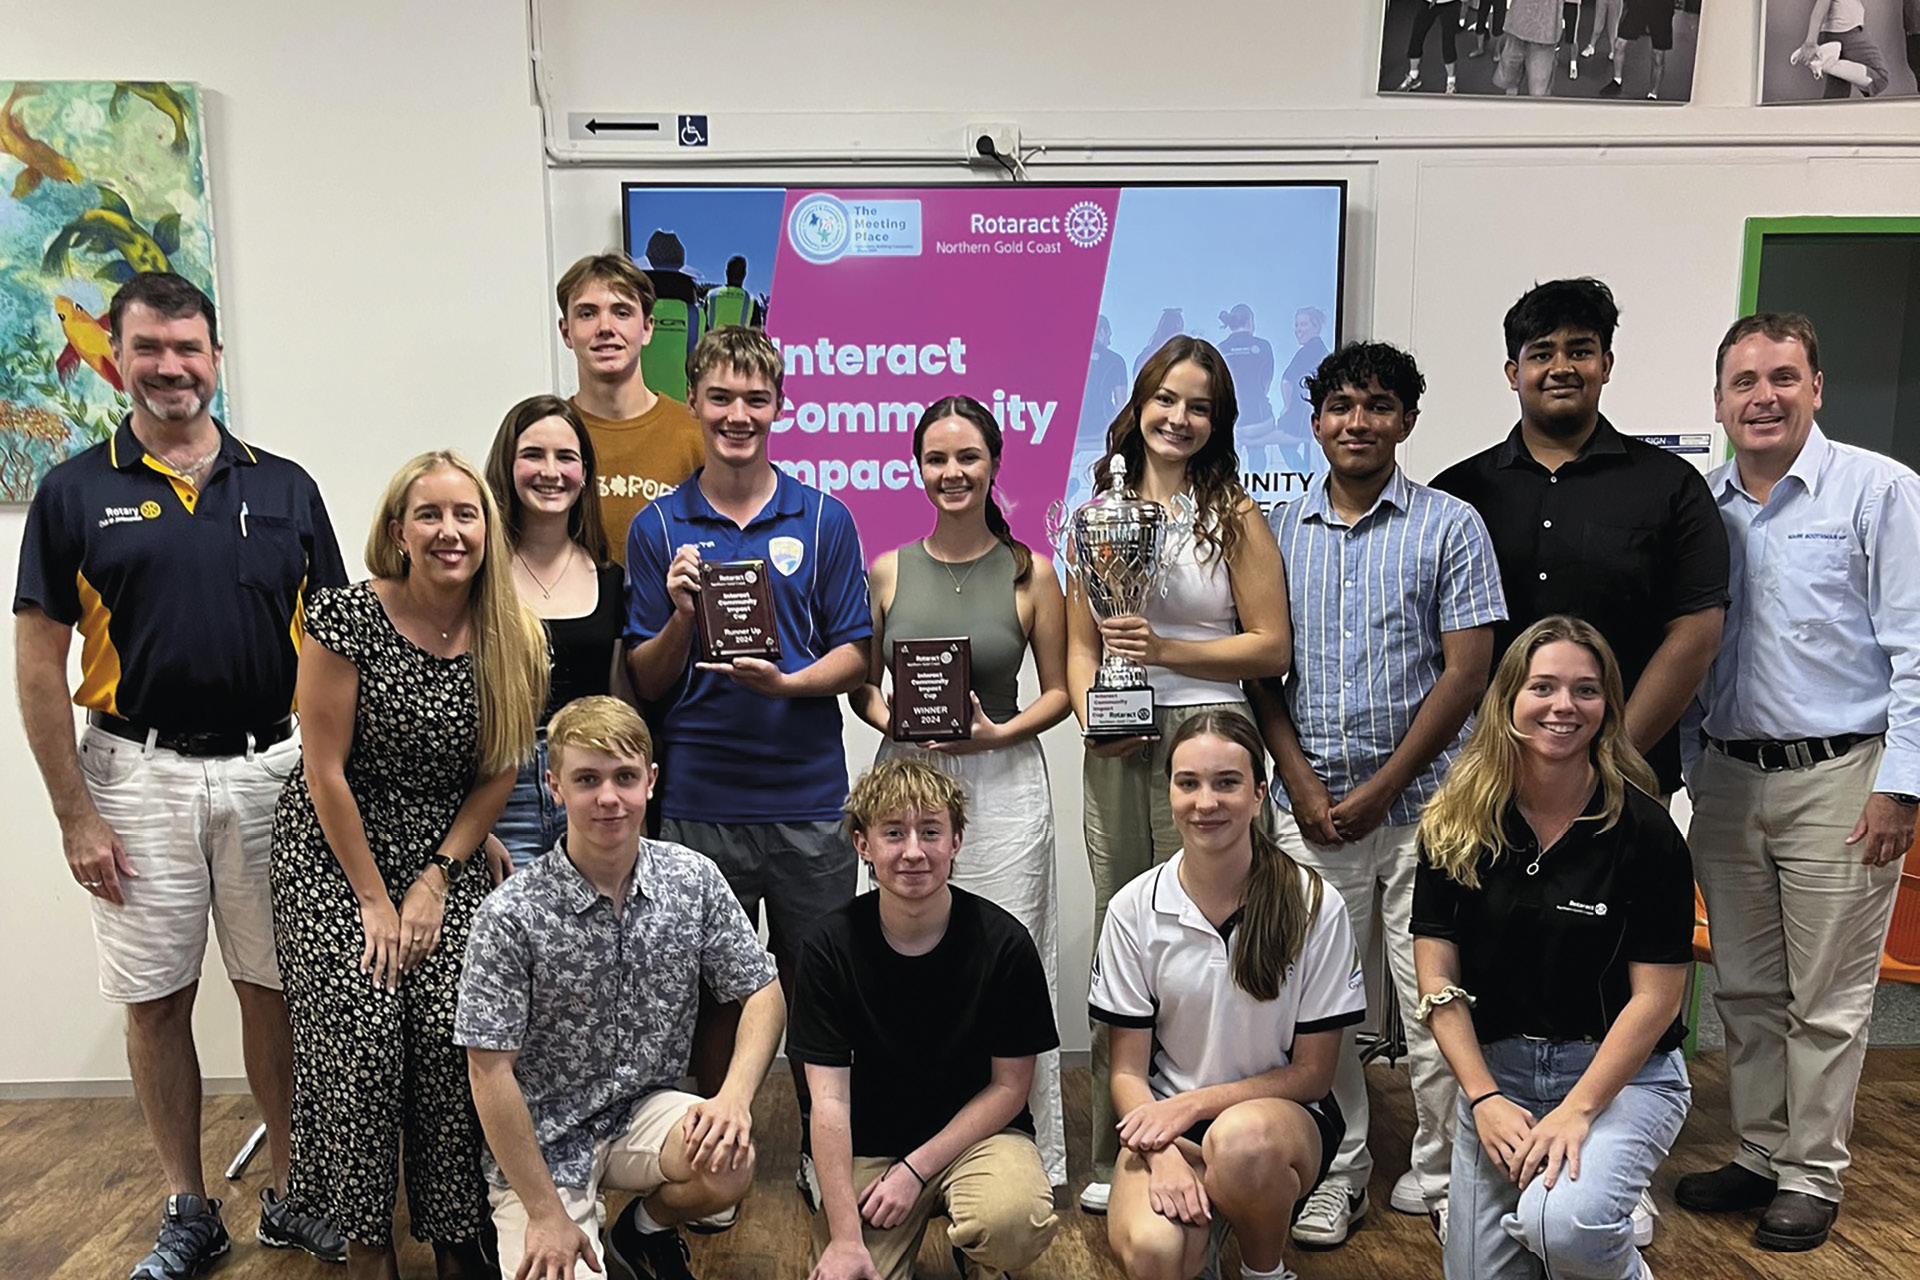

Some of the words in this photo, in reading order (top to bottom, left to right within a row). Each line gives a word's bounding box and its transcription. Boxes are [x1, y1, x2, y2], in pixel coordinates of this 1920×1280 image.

[854, 206, 877, 216] The
[855, 219, 906, 231] Meeting
[971, 214, 1060, 234] Rotaract
[855, 232, 889, 242] Place
[936, 241, 990, 254] Northern
[994, 241, 1023, 254] Gold
[1027, 241, 1061, 254] Coast
[772, 337, 967, 376] nteract
[105, 507, 139, 518] Rotary
[719, 574, 745, 582] Rotaract
[718, 599, 757, 607] Community
[733, 613, 748, 621] Cup
[724, 628, 750, 636] Runner
[750, 627, 762, 636] Up
[735, 635, 753, 644] 2024
[911, 678, 949, 686] Community
[918, 685, 942, 693] Impact
[913, 705, 948, 715] WINNER
[921, 715, 941, 724] 2024
